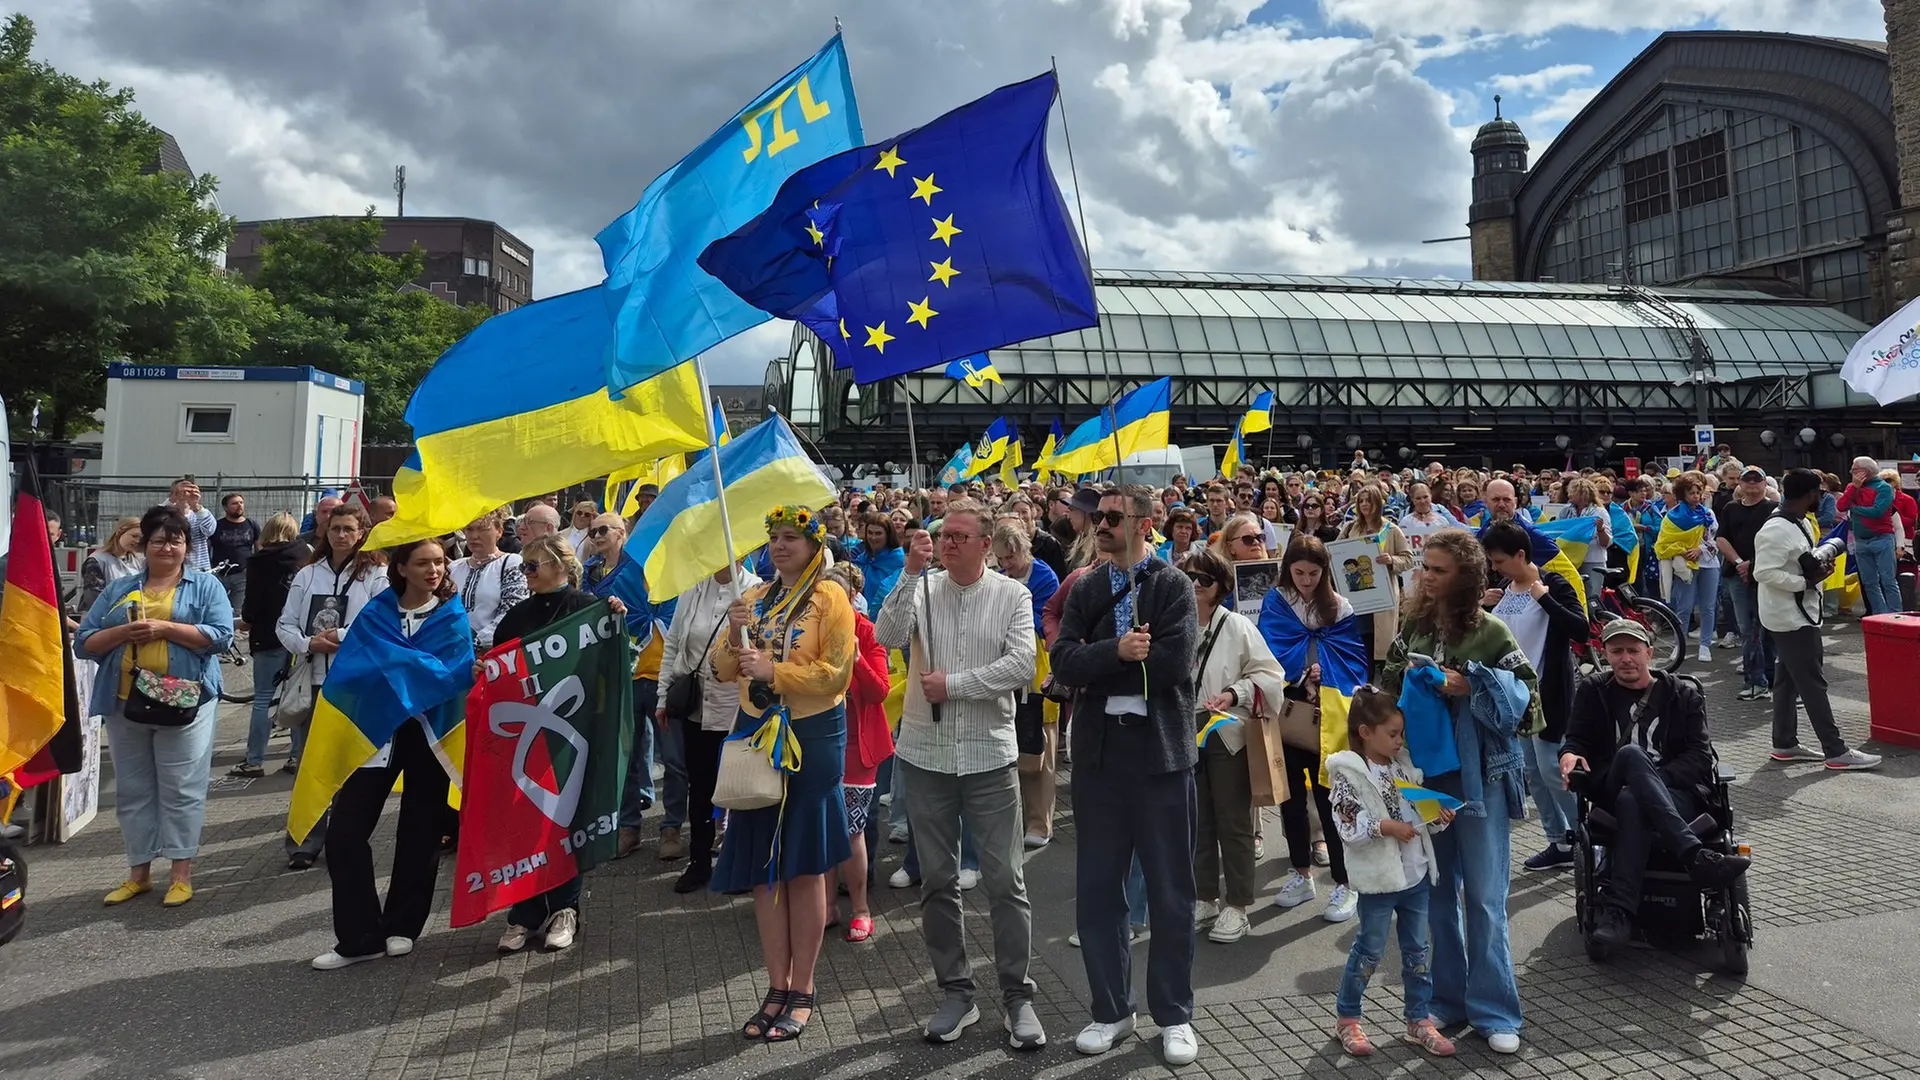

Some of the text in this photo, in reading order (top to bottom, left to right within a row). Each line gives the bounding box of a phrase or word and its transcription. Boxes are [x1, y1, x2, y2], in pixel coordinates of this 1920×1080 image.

[123, 368, 166, 377] 0811026
[525, 634, 568, 666] TO
[466, 871, 485, 894] 2
[489, 851, 548, 886] зрдн
